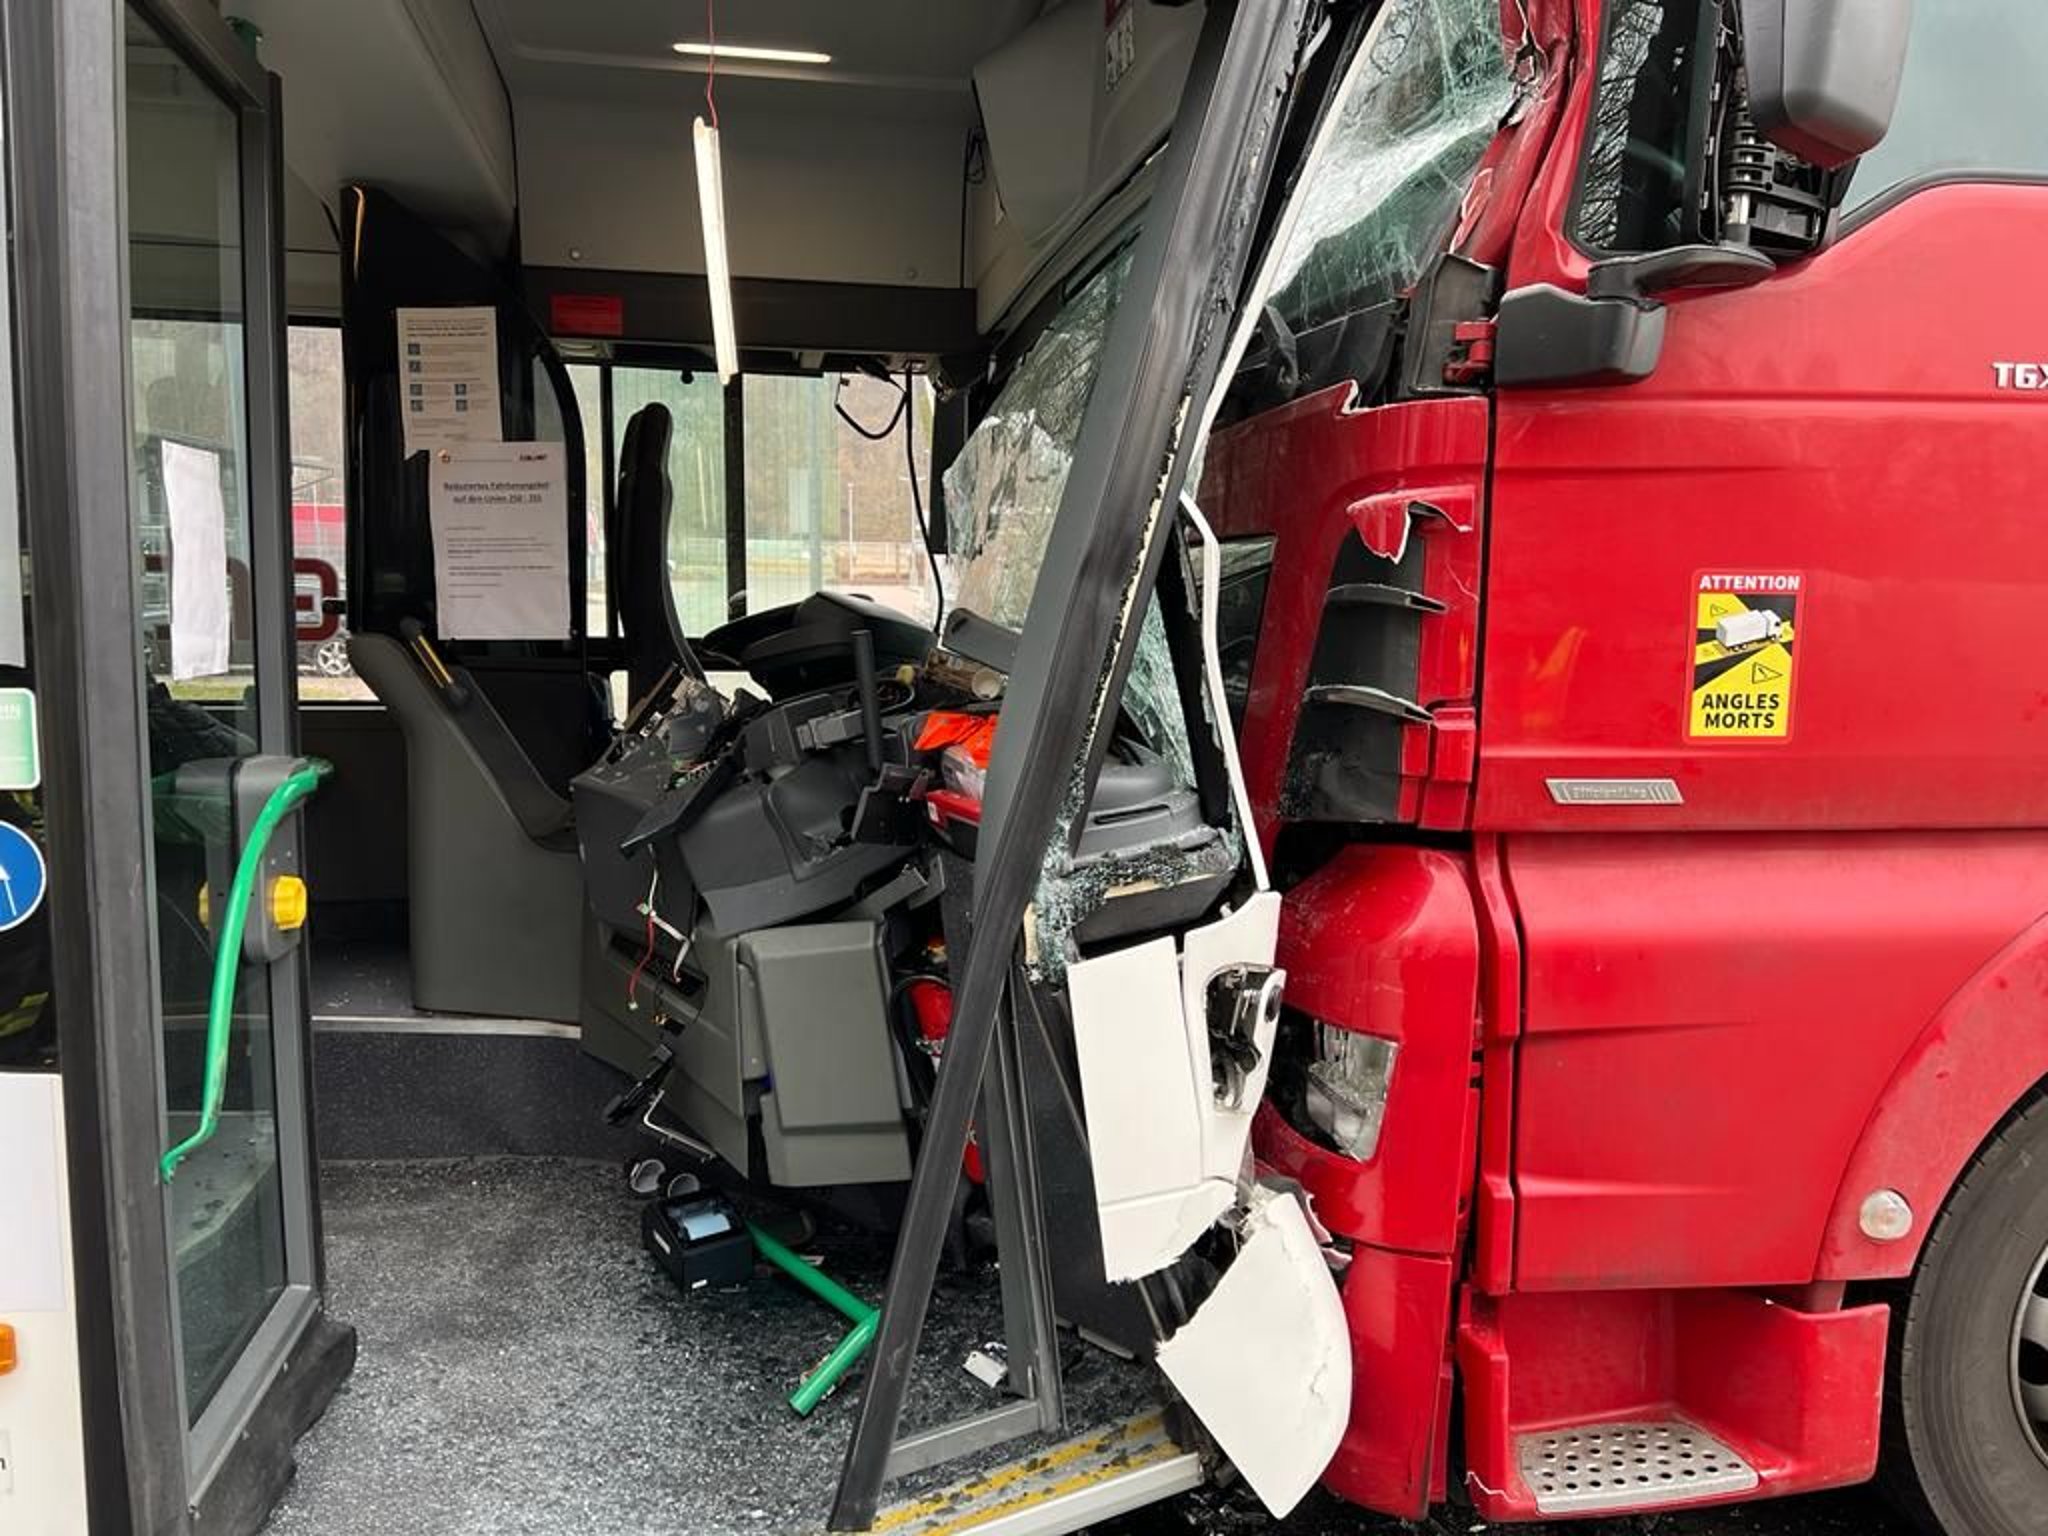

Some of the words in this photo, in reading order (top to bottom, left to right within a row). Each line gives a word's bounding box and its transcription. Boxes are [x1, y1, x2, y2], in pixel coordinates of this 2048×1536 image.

[1699, 575, 1800, 590] ATTENTION
[1702, 693, 1780, 710] ANGLES
[1705, 712, 1775, 729] MORTS
